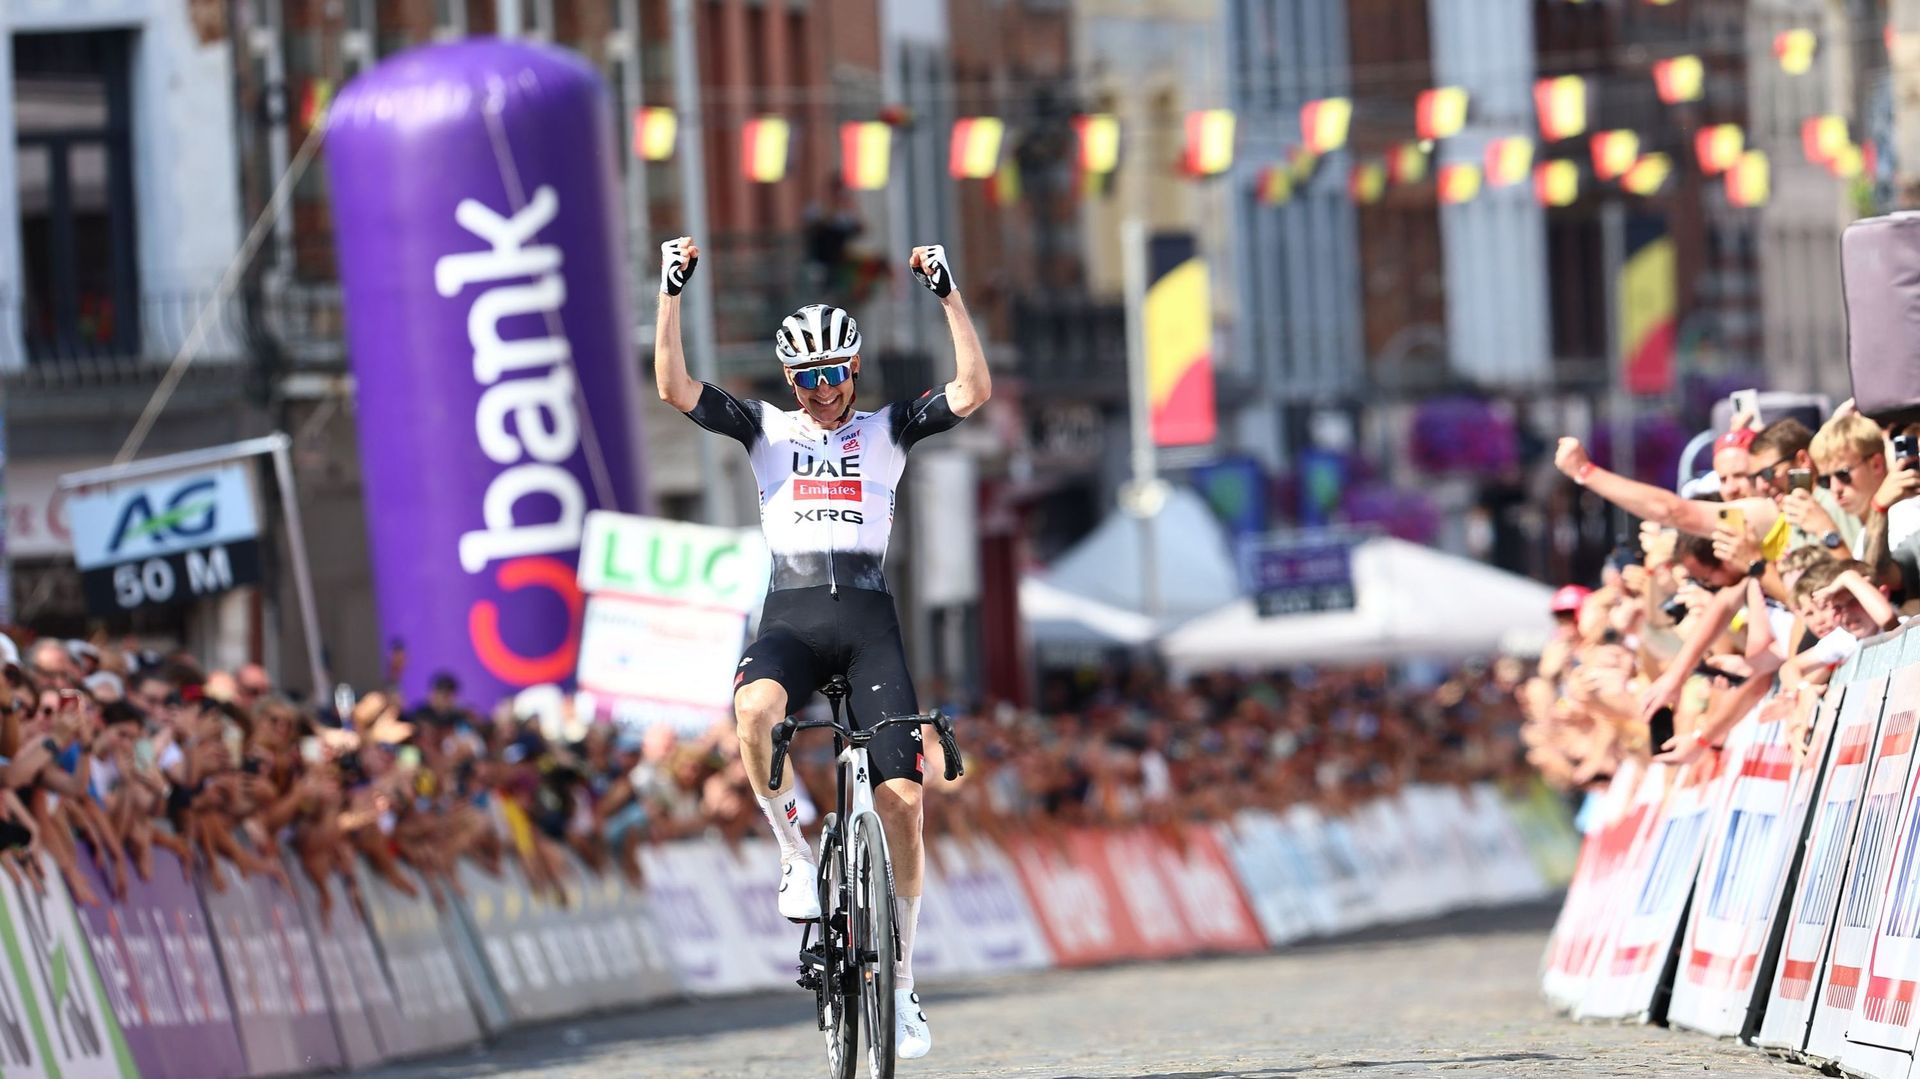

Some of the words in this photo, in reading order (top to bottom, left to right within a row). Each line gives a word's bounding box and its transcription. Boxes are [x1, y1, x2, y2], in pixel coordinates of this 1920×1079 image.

[793, 451, 861, 477] UAE
[800, 484, 856, 496] Emirates
[108, 478, 218, 554] AG
[793, 508, 864, 524] XRG
[113, 558, 175, 608] 50
[185, 545, 233, 595] M
[602, 531, 741, 595] LUC
